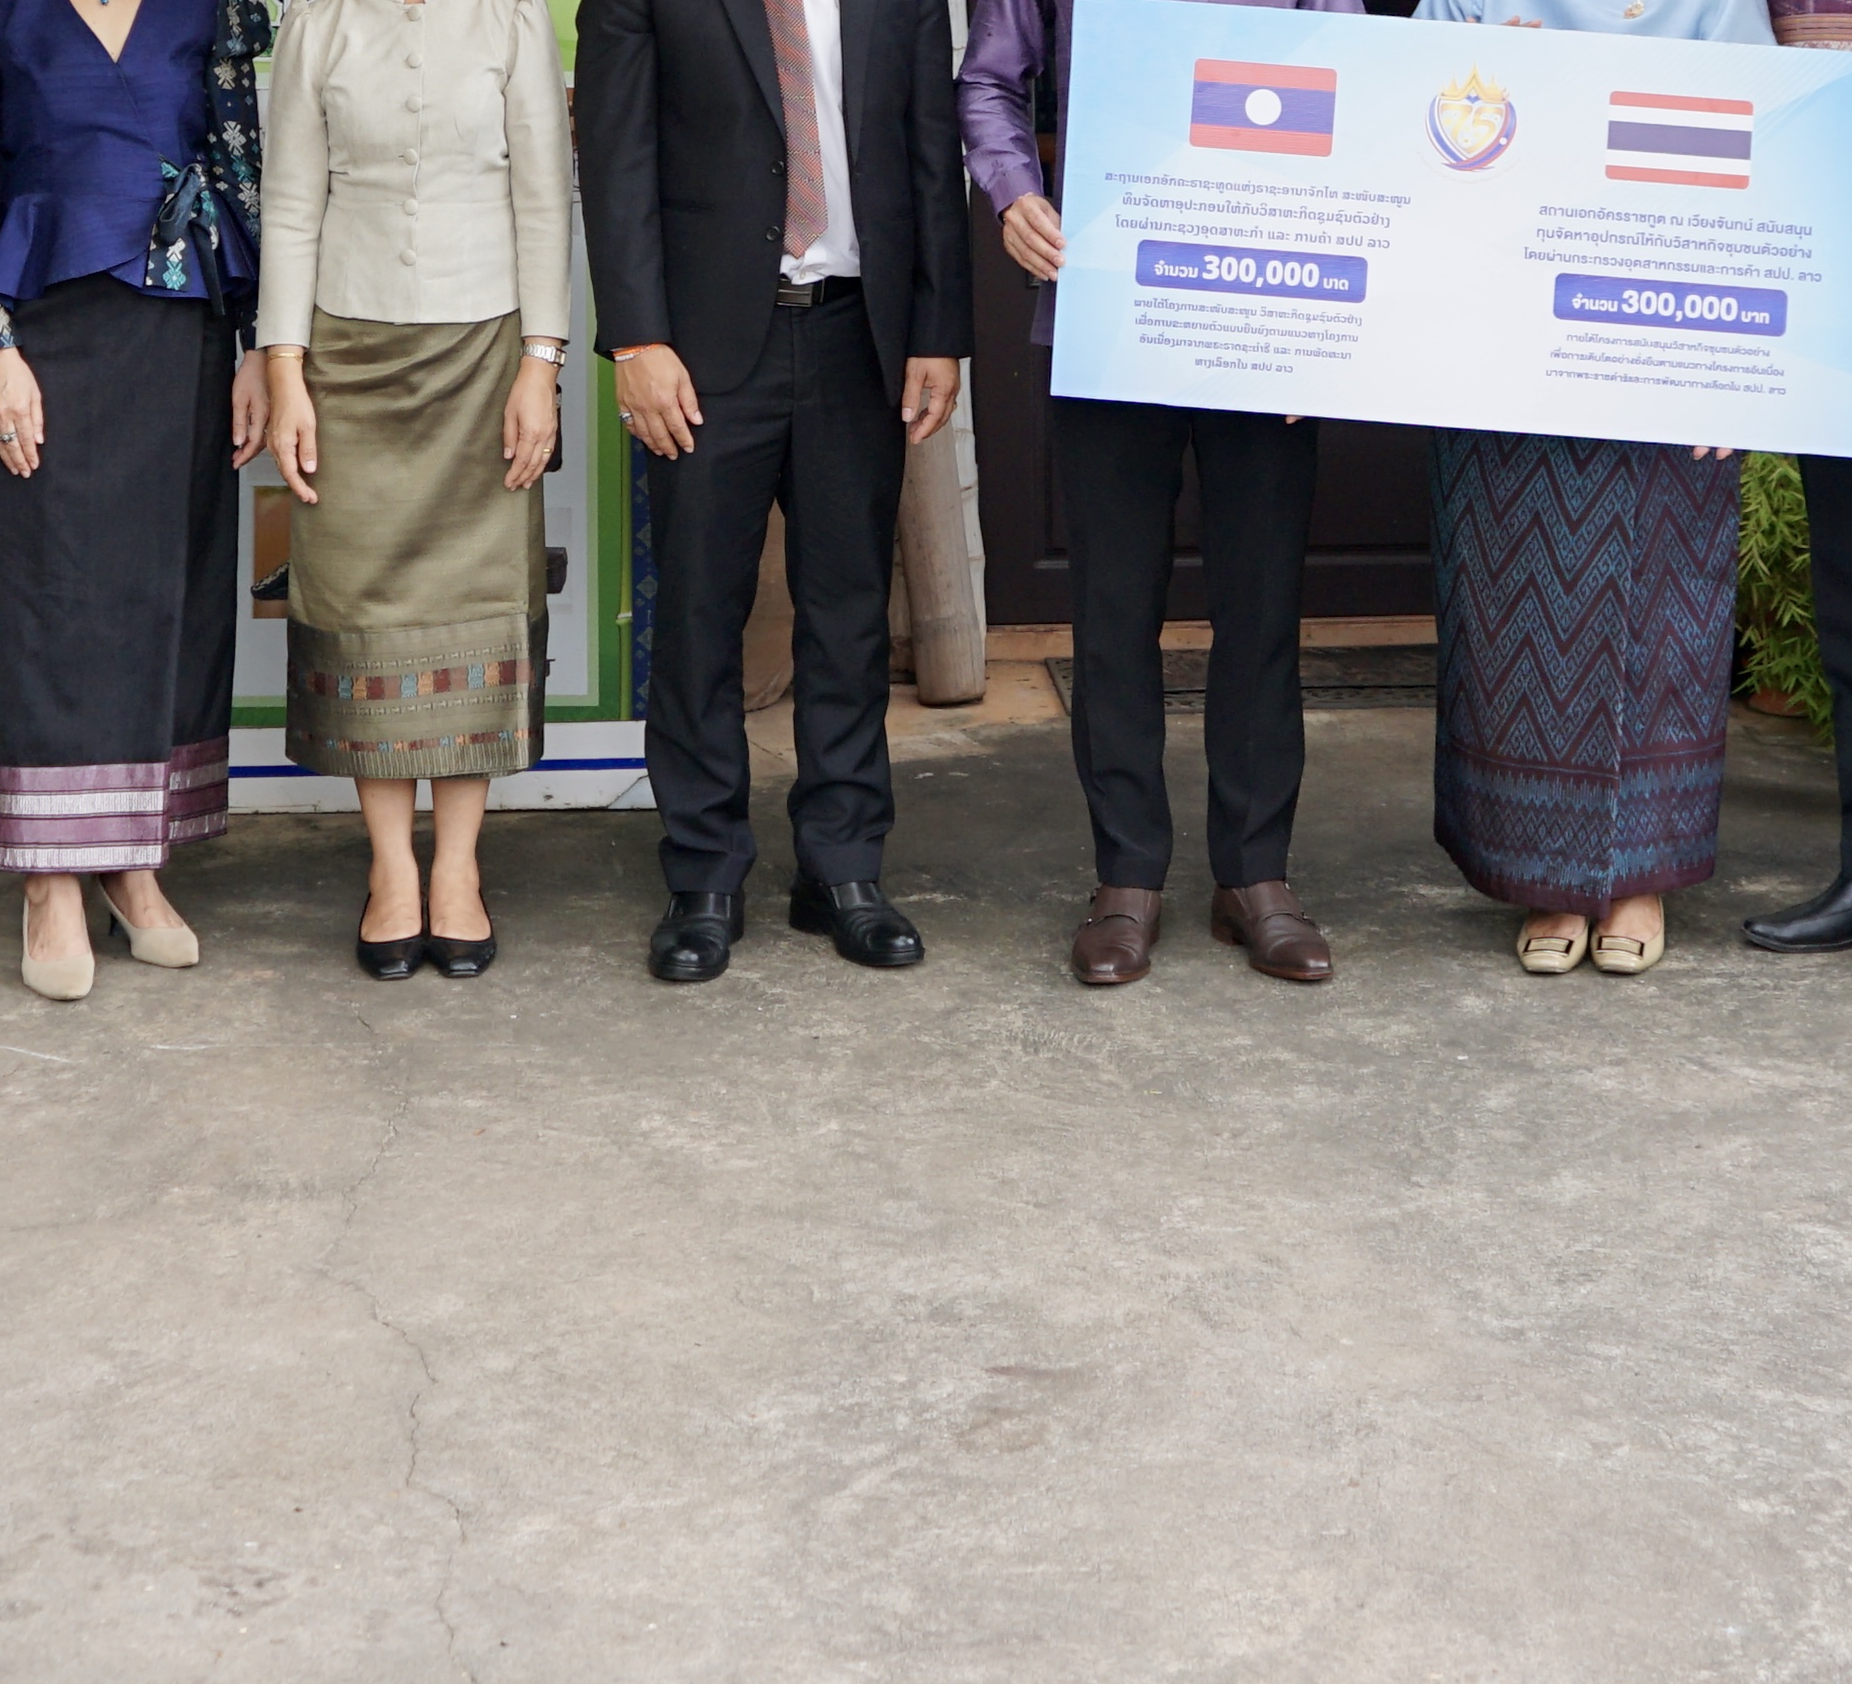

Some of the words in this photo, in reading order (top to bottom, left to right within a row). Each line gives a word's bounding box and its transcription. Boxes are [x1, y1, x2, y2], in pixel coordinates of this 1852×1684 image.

[1267, 230, 1290, 241] ແລະ
[1294, 230, 1332, 244] ການຄ້າ
[1335, 234, 1363, 247] ສປປ
[1367, 237, 1391, 249] ລາວ
[1539, 205, 1666, 228] สถานเอกอัครราชทูต
[1670, 215, 1684, 226] ณ
[1687, 213, 1753, 231] เวียงจันทน์
[1756, 220, 1812, 240] สนับสนุน
[1154, 260, 1198, 279] ຈຳນວນ
[1201, 254, 1320, 289] 300,000
[1323, 276, 1350, 291] ບາດ
[1524, 246, 1760, 278] โดยผ่านกระทรวงอุตสาหกรรมและการค้า
[1764, 266, 1795, 280] สปป.
[1798, 271, 1823, 283] ลาว
[1571, 292, 1618, 312] จำนวน
[1621, 289, 1739, 322] 300,000
[1741, 309, 1771, 325] บาท
